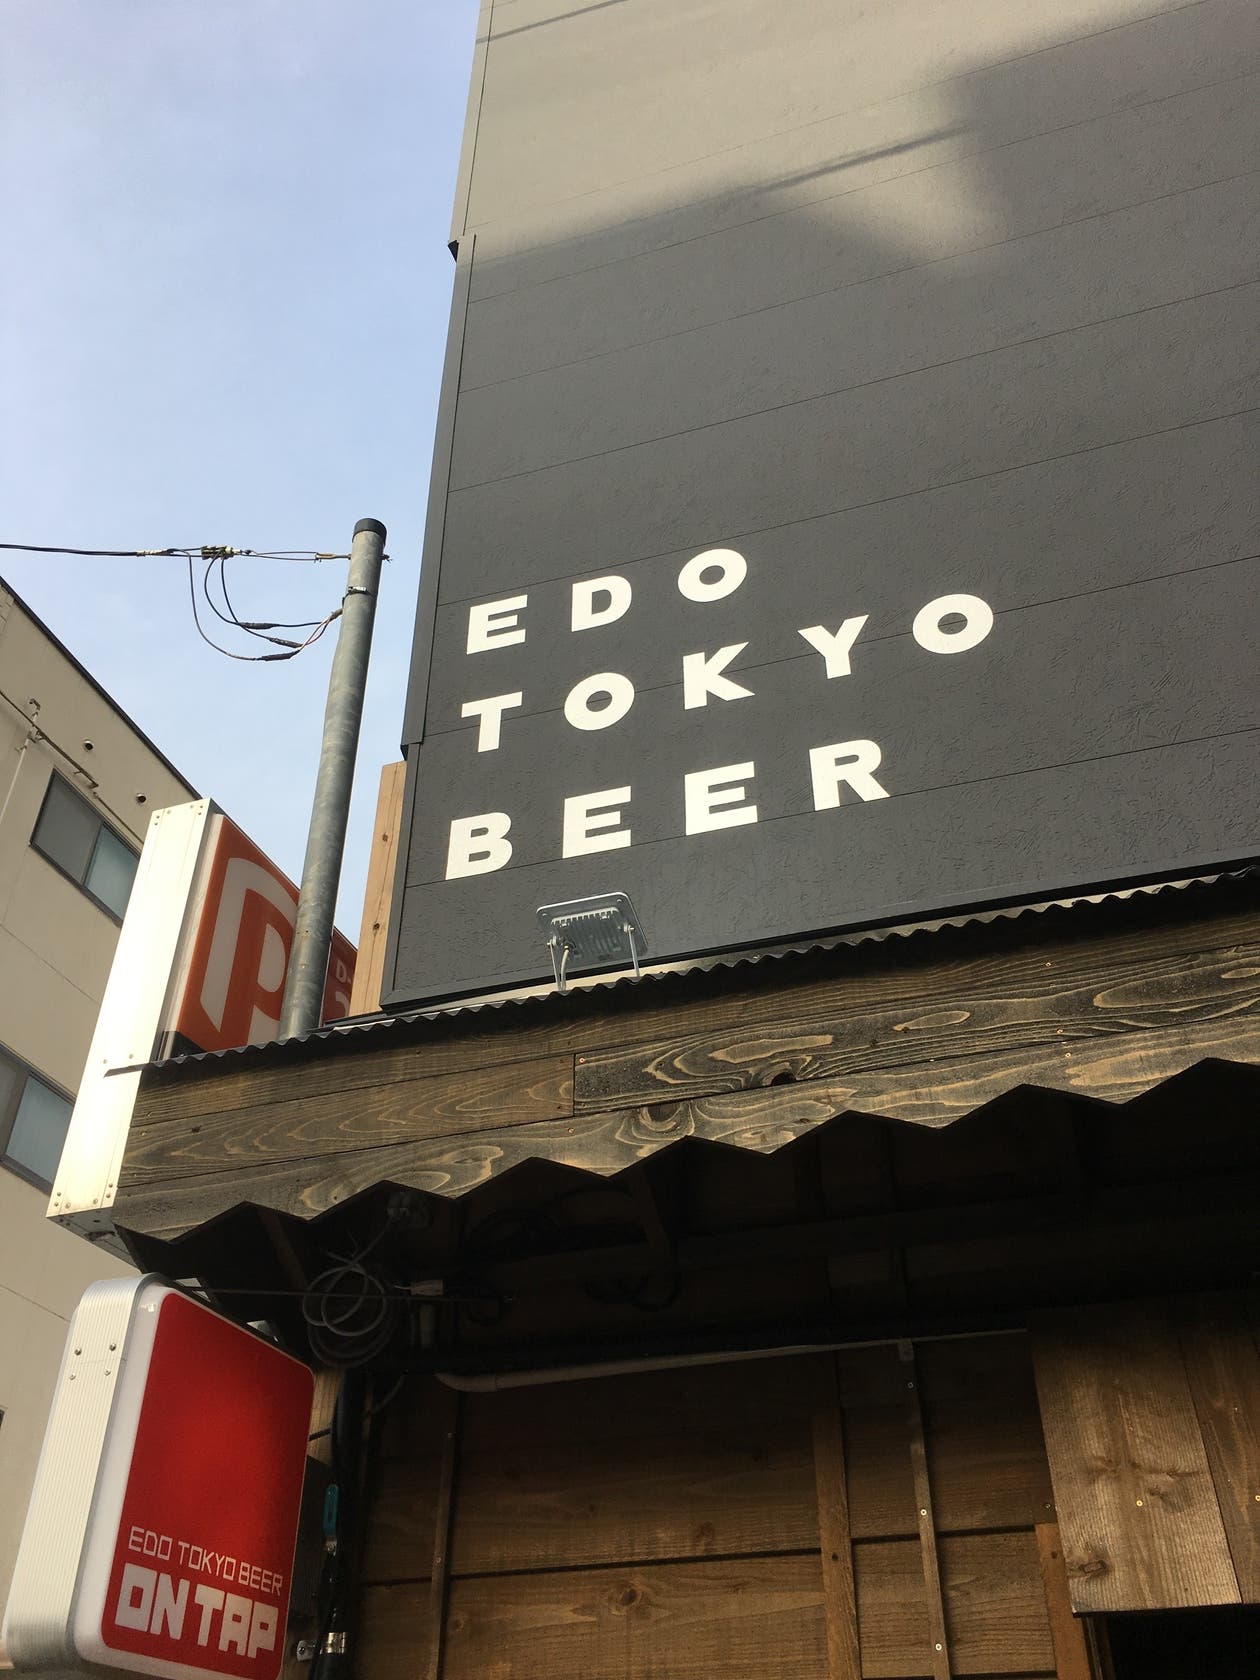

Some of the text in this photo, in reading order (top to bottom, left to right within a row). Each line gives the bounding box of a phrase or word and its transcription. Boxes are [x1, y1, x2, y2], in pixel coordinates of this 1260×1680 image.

[466, 548, 747, 655] EDO
[461, 593, 994, 753] TOKYO
[445, 739, 890, 881] BEER
[115, 1562, 279, 1658] ON TAP
[128, 1525, 284, 1596] EDO TOKYO BEER
